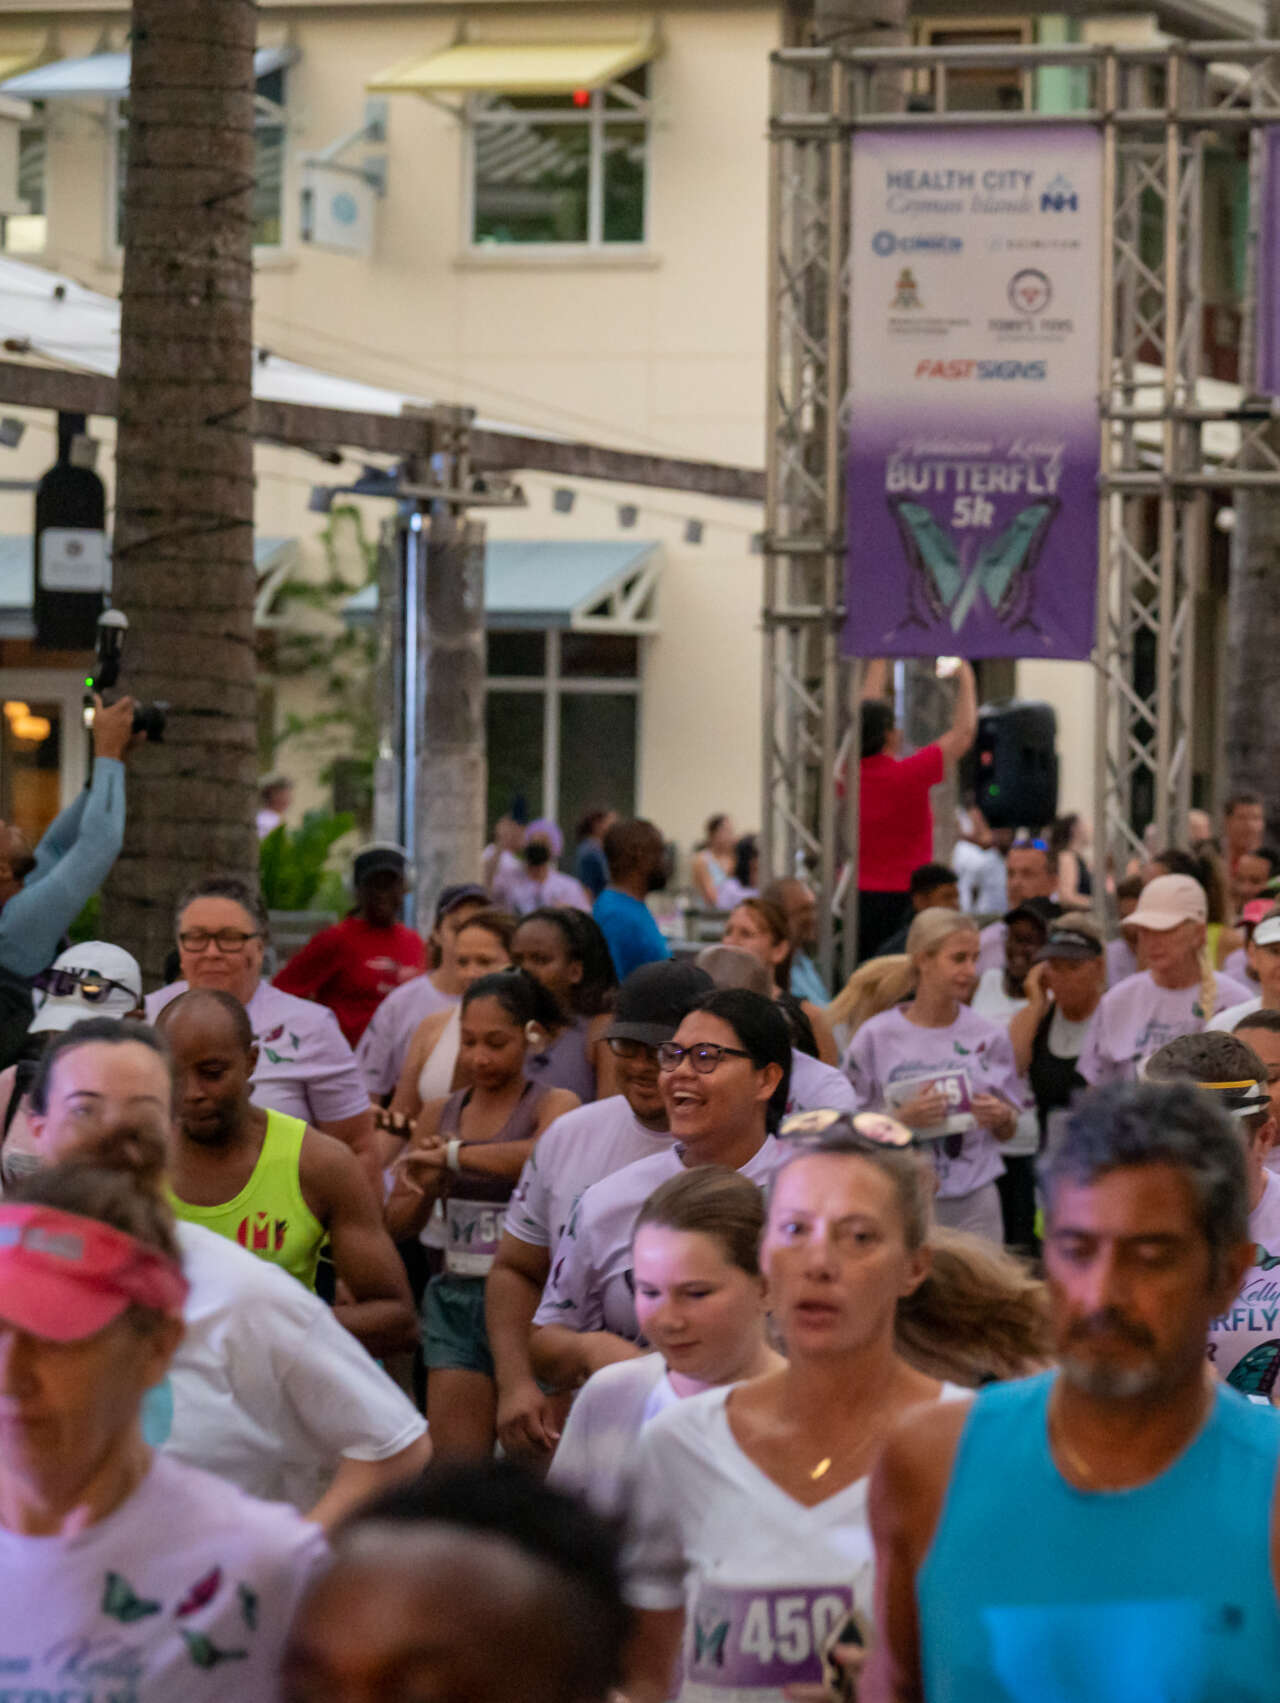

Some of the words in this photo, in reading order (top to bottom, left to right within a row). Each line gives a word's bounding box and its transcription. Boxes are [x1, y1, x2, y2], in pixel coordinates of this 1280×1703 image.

[885, 169, 974, 190] HEALTH
[982, 169, 1034, 190] CITY
[915, 358, 1047, 380] FASTSIGNS
[885, 462, 1062, 495] BUTTERFLY
[951, 493, 996, 528] 5k
